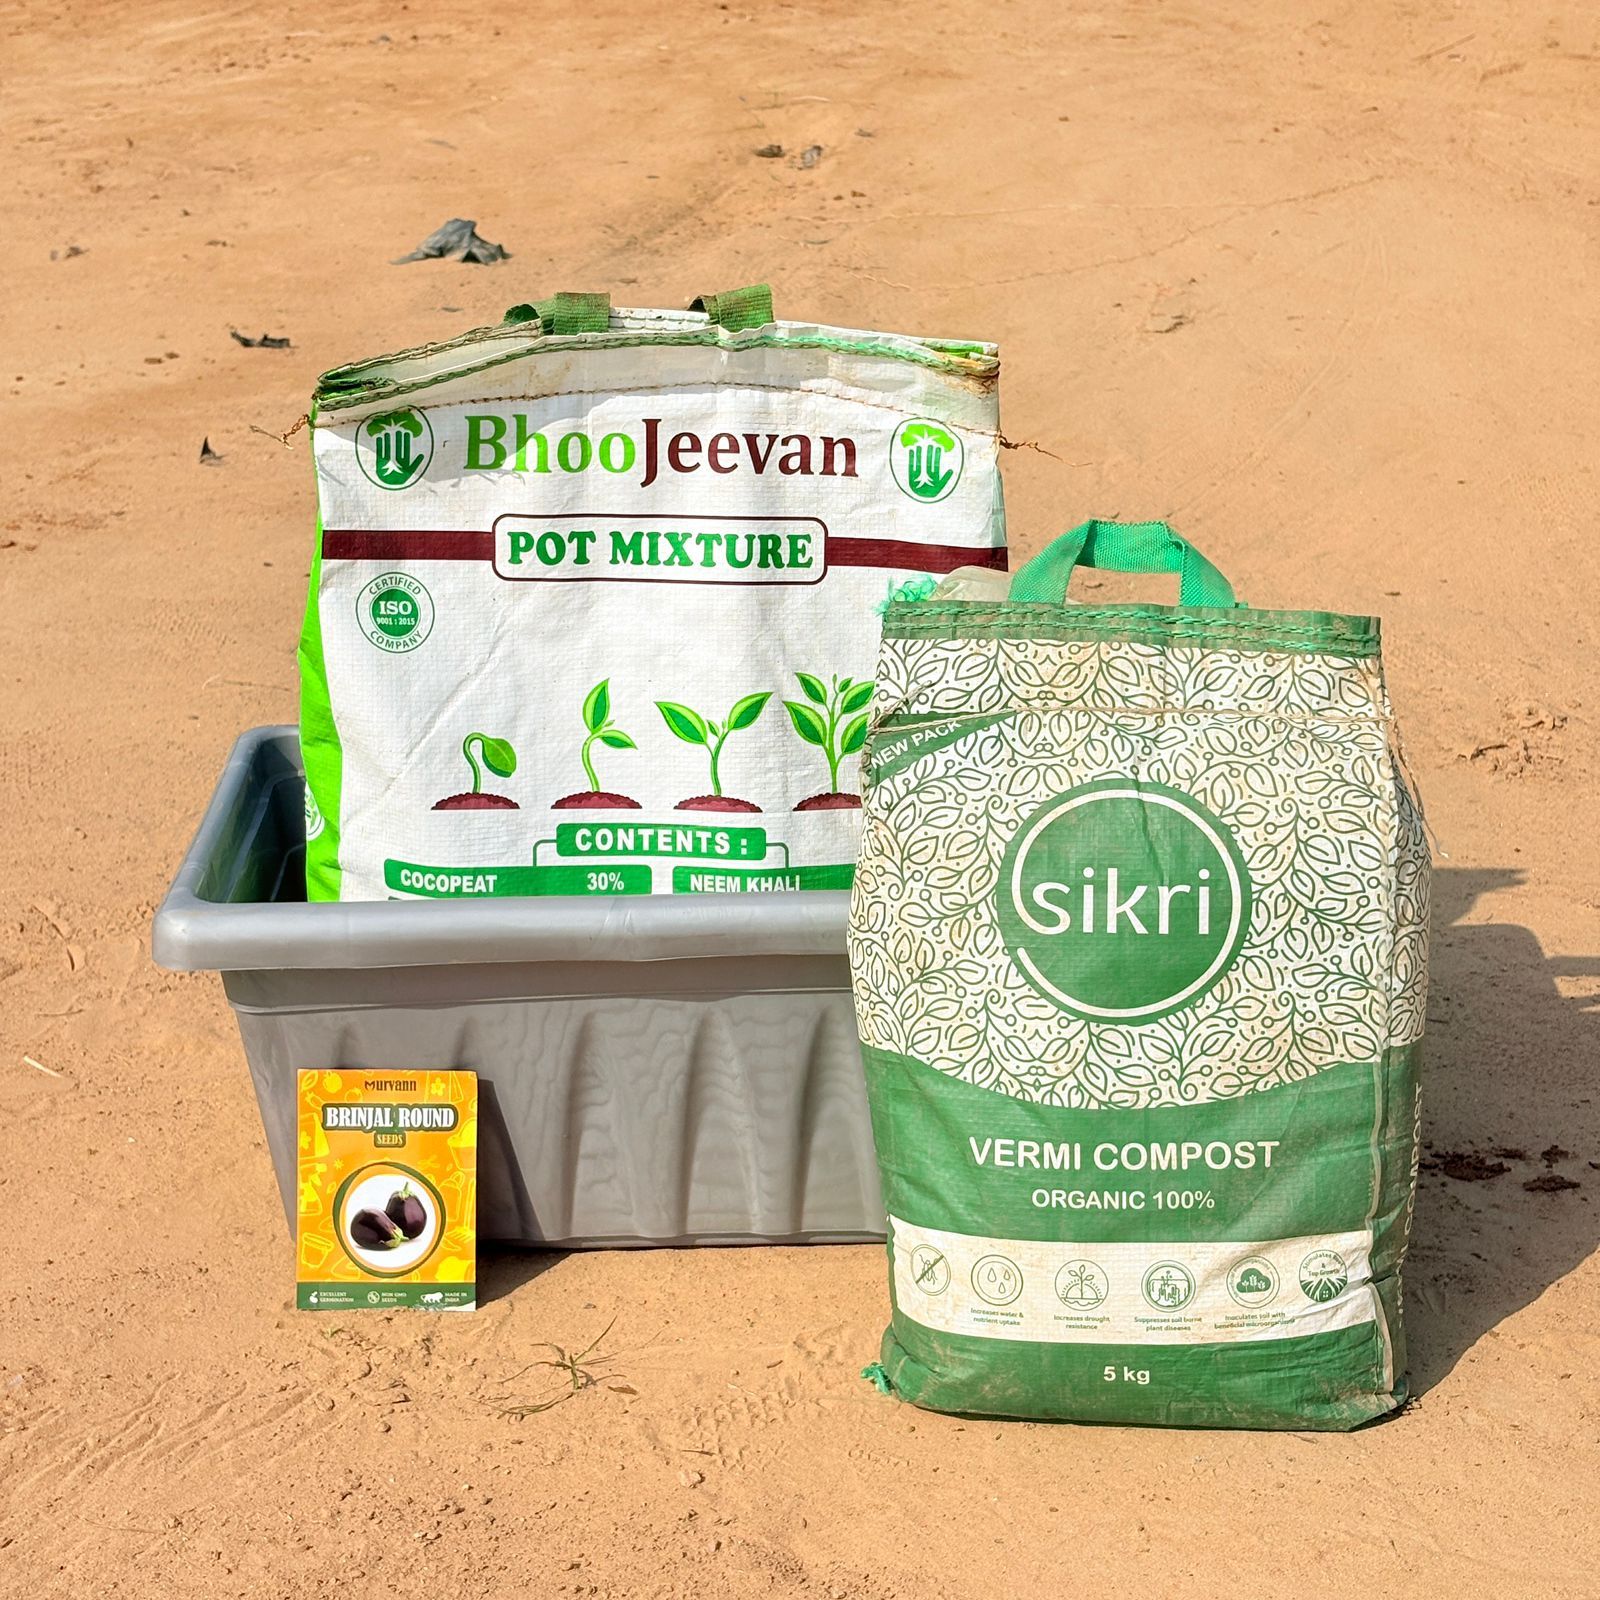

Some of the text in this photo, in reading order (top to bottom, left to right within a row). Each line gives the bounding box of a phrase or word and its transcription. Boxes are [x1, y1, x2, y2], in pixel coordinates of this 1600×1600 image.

[463, 414, 859, 488] BhooJeevan
[507, 531, 813, 569] POT MIXTURE
[369, 576, 421, 595] CERTIFIED
[379, 600, 412, 615] ISO
[370, 630, 423, 649] COMPANY
[871, 720, 962, 769] NEW PACK
[575, 828, 731, 855] CONTENTS
[400, 869, 625, 892] COCOPEAT 30%
[690, 874, 800, 892] NEEM KHALI
[1031, 867, 1211, 936] sikri
[364, 1080, 417, 1091] Murvann
[326, 1106, 455, 1130] BRINJAL ROUND
[377, 1134, 403, 1145] SEEDS
[968, 1136, 1280, 1171] VERMI COMPOST
[1031, 1189, 1215, 1210] ORGANIC 100%
[970, 1307, 999, 1316] Increases
[1103, 1366, 1150, 1385] 5 kg
